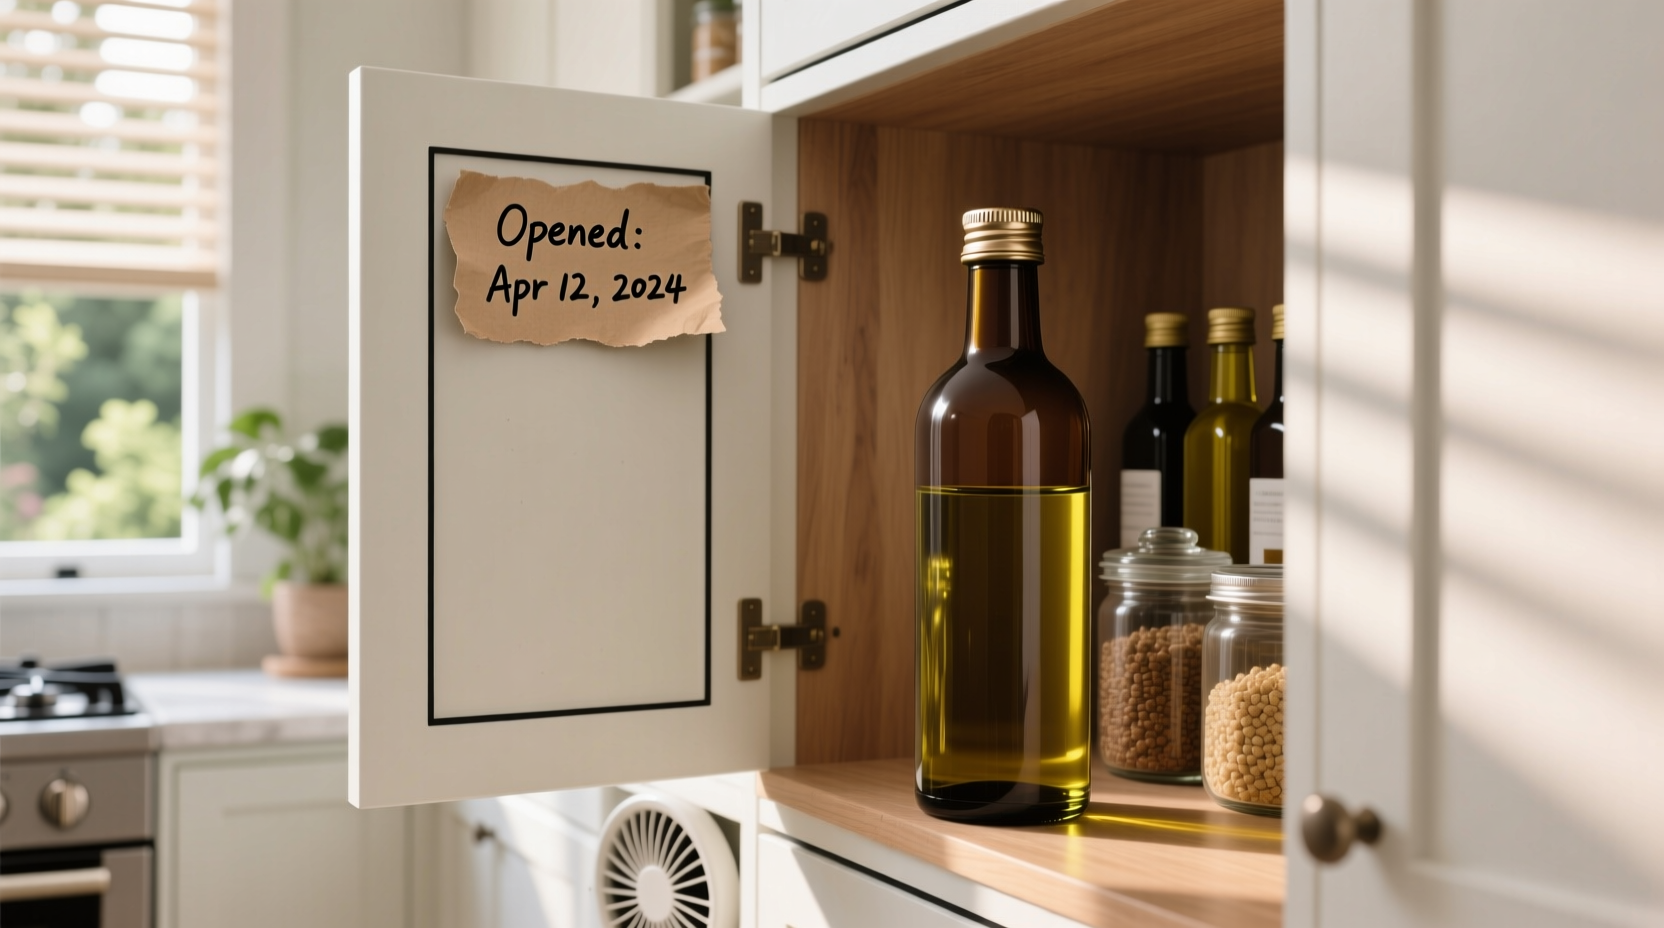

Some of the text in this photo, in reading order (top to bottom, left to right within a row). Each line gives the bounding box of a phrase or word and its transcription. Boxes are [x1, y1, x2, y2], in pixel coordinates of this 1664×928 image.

[496, 203, 643, 262] Opened:
[485, 264, 687, 317] Apr 12, 2024
